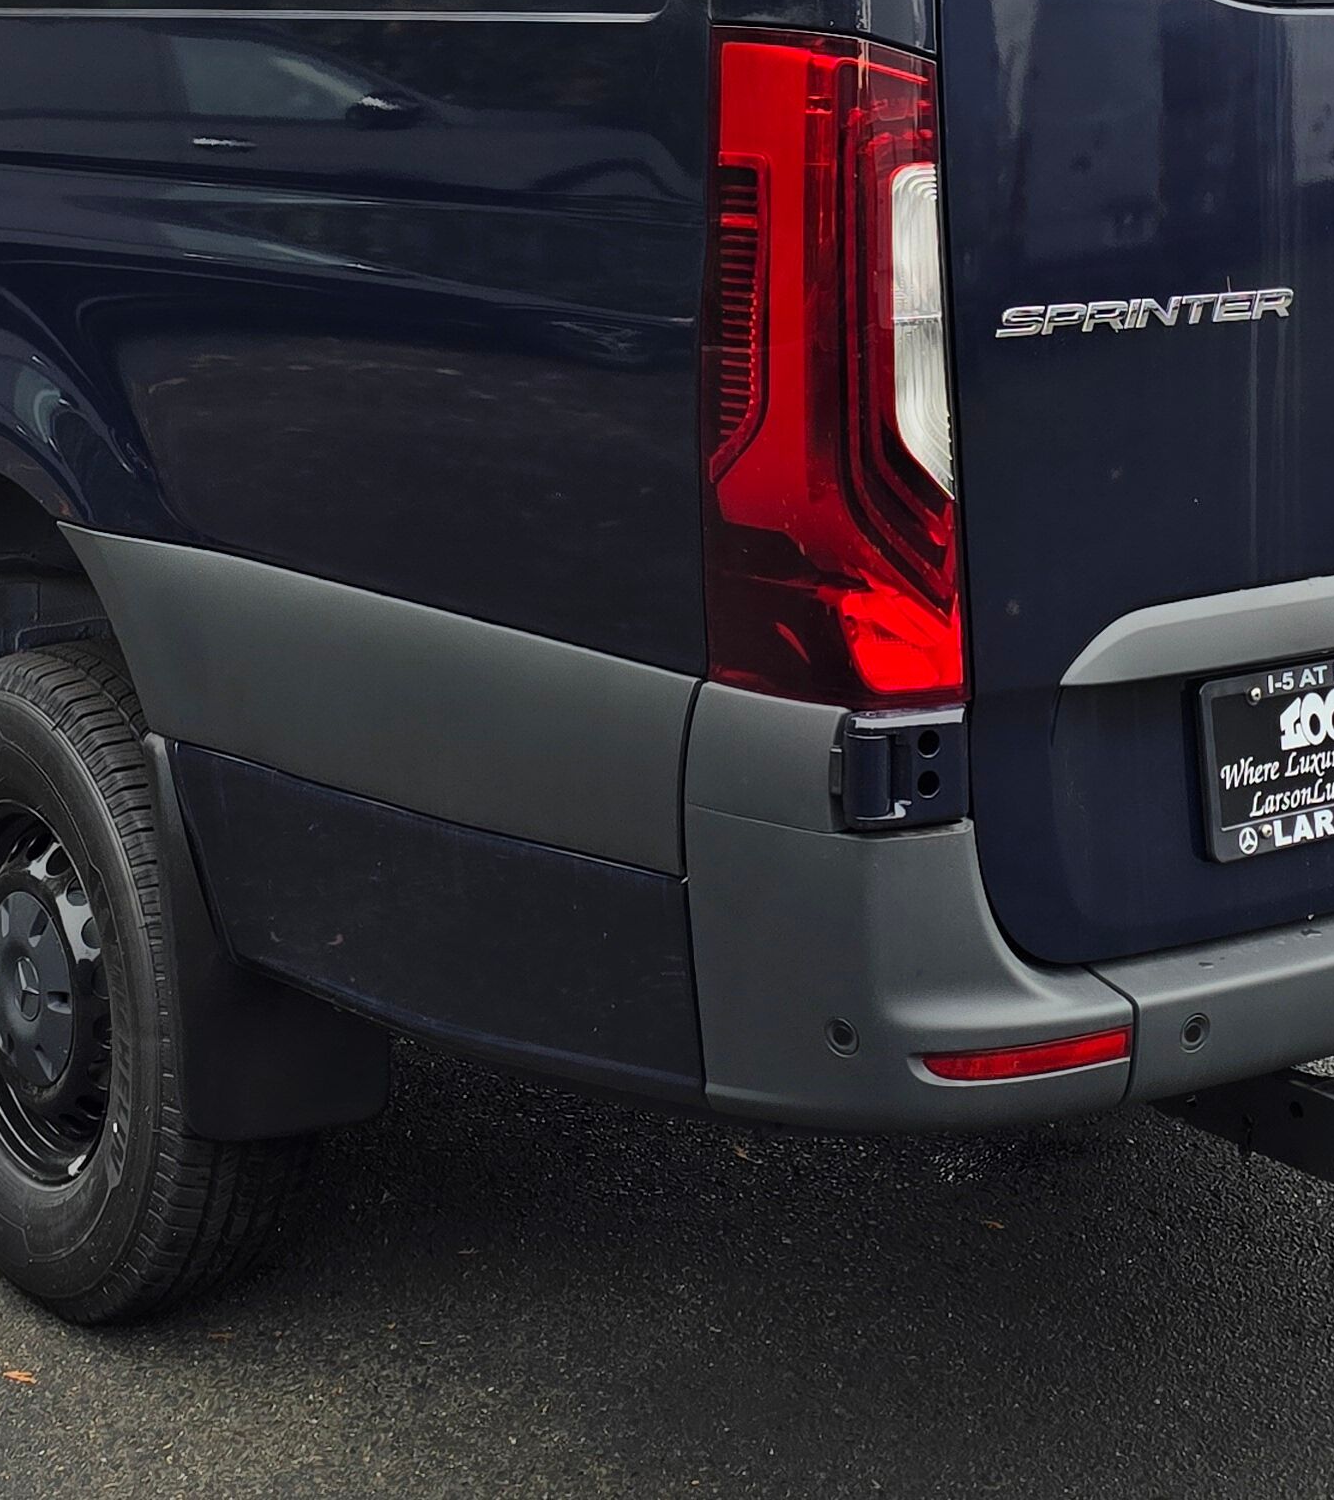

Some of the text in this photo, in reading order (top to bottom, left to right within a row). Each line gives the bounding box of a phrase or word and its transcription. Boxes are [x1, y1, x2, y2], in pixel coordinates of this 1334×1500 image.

[995, 288, 1295, 338] SPRINTER
[1267, 672, 1294, 694] I-5
[1299, 664, 1328, 690] AT
[1220, 756, 1280, 790] Where
